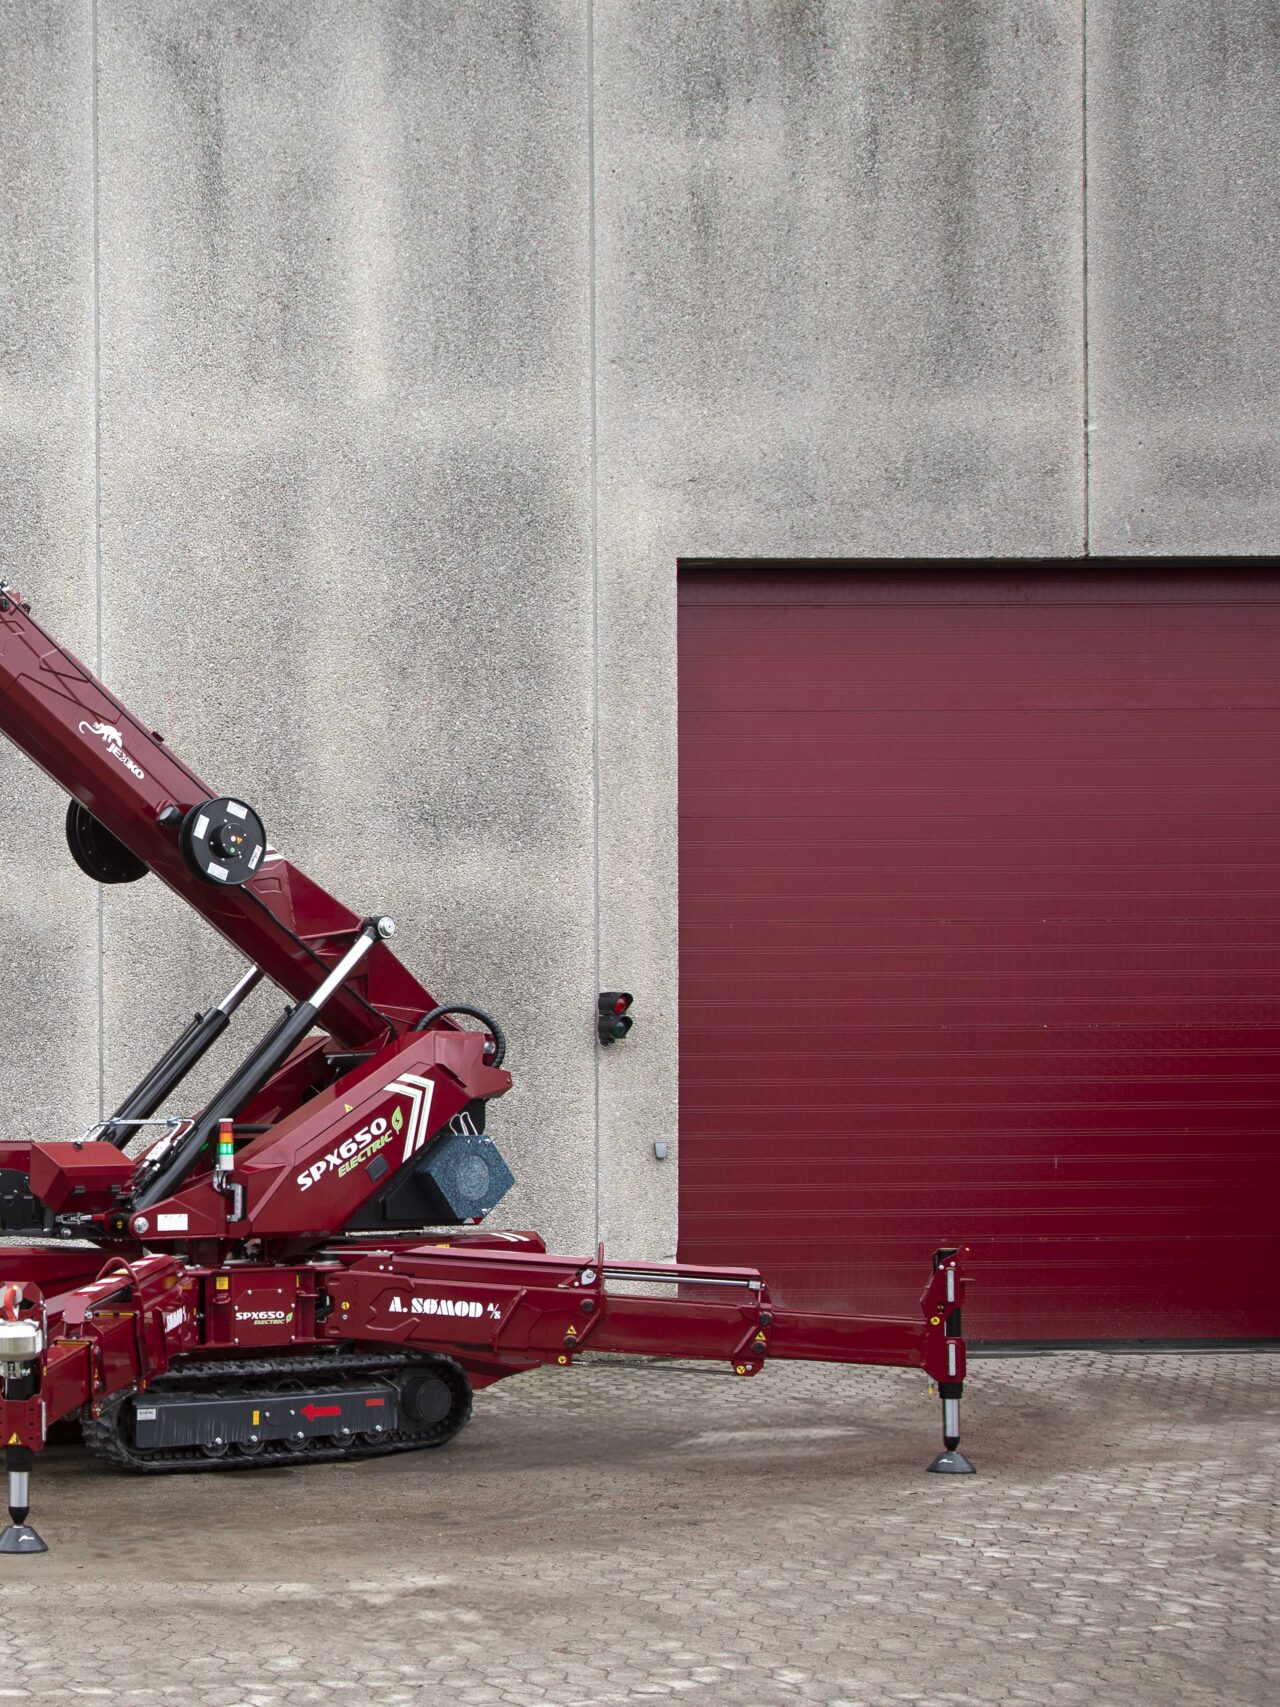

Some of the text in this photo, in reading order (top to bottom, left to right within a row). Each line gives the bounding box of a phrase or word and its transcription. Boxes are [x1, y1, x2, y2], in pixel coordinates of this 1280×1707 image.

[296, 1117, 387, 1192] SPX650
[337, 1129, 393, 1178] ELECTRIC
[235, 1310, 285, 1321] SPX650
[388, 1296, 408, 1313] A.
